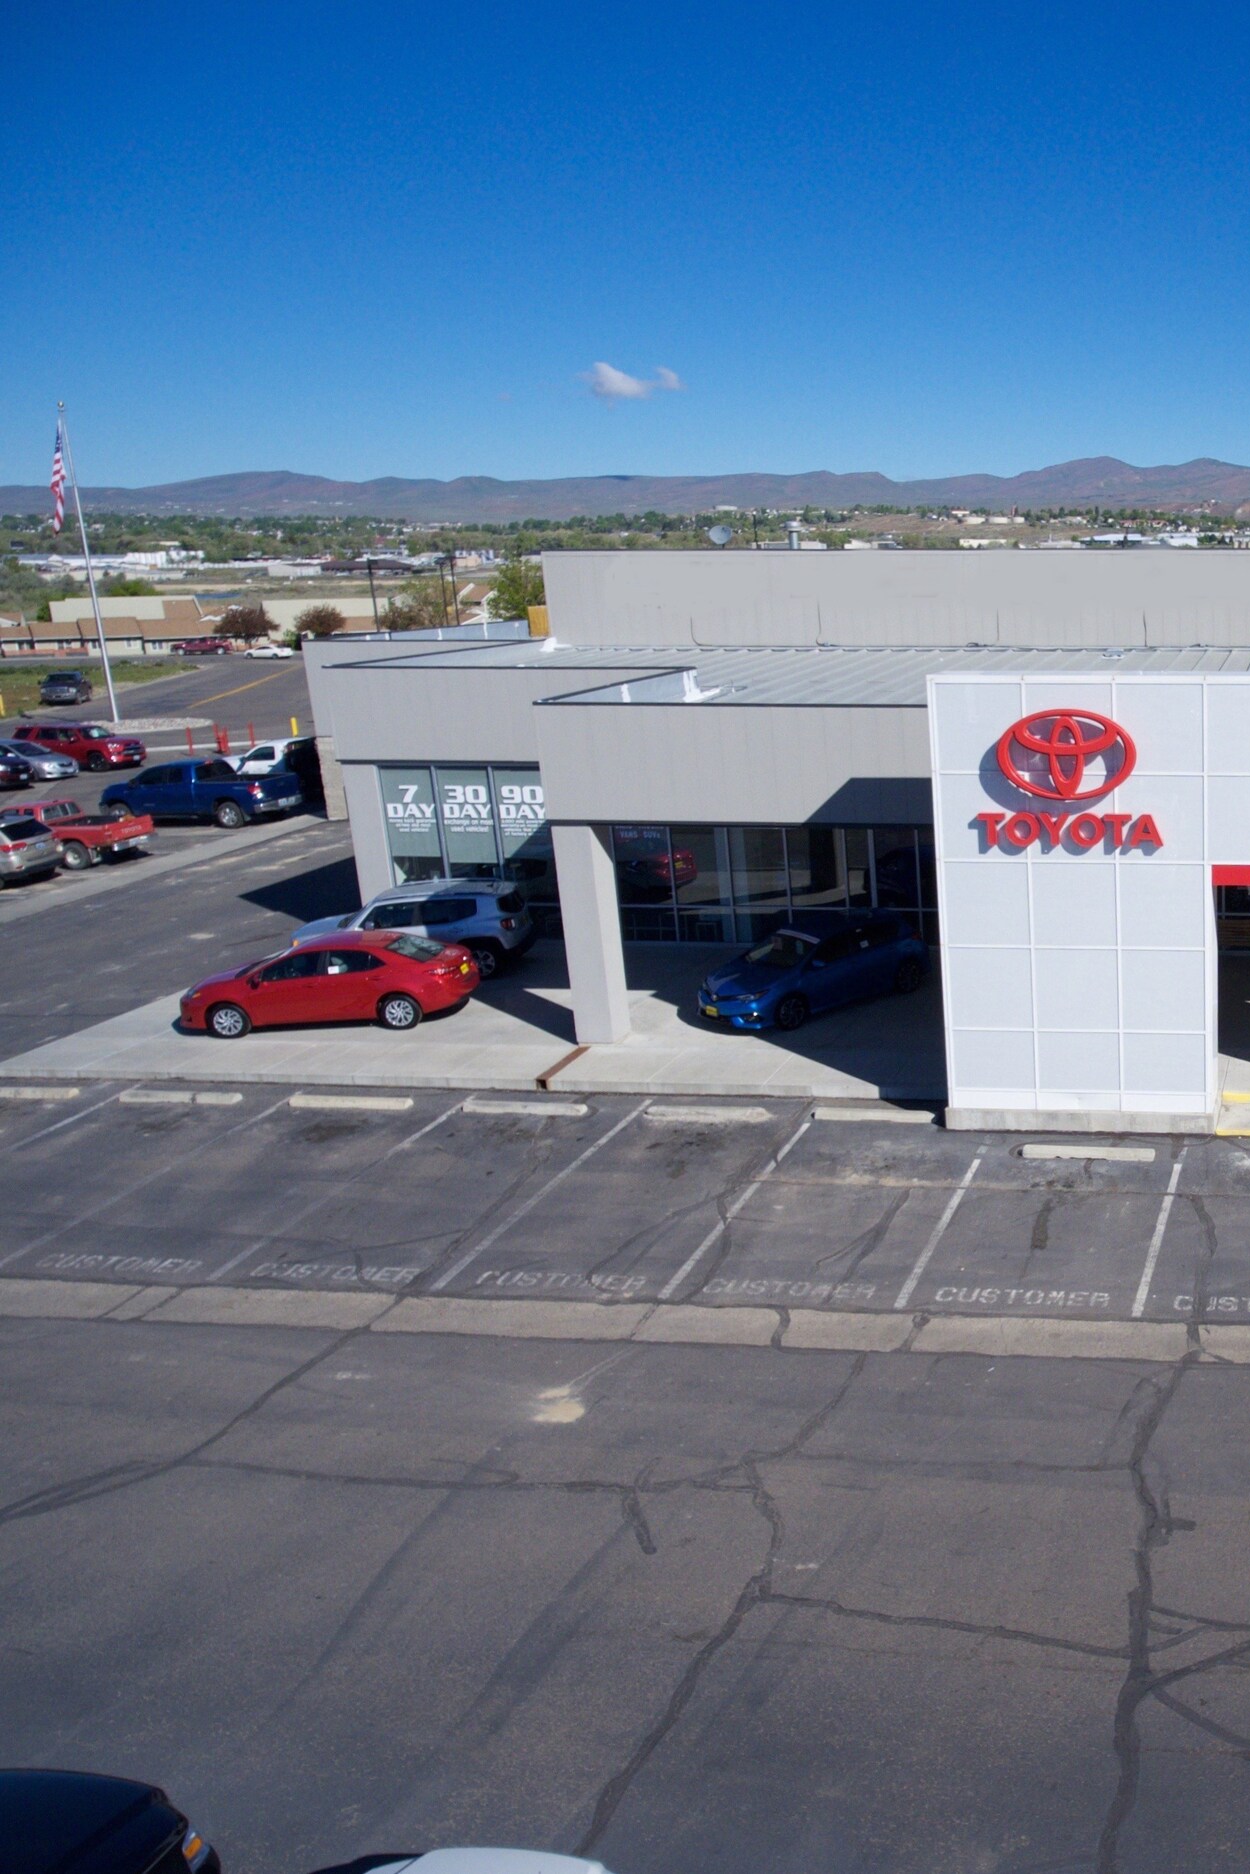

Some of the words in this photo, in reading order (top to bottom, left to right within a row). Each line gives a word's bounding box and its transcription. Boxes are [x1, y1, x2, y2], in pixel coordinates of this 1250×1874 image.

[398, 785, 418, 803] 7
[444, 785, 487, 803] 30
[501, 785, 544, 804] 90
[386, 803, 435, 818] DAY
[442, 804, 491, 818] DAY
[499, 804, 545, 819] DAY
[977, 812, 1163, 848] TOYOTA
[934, 1286, 1111, 1307] CUSTOMER
